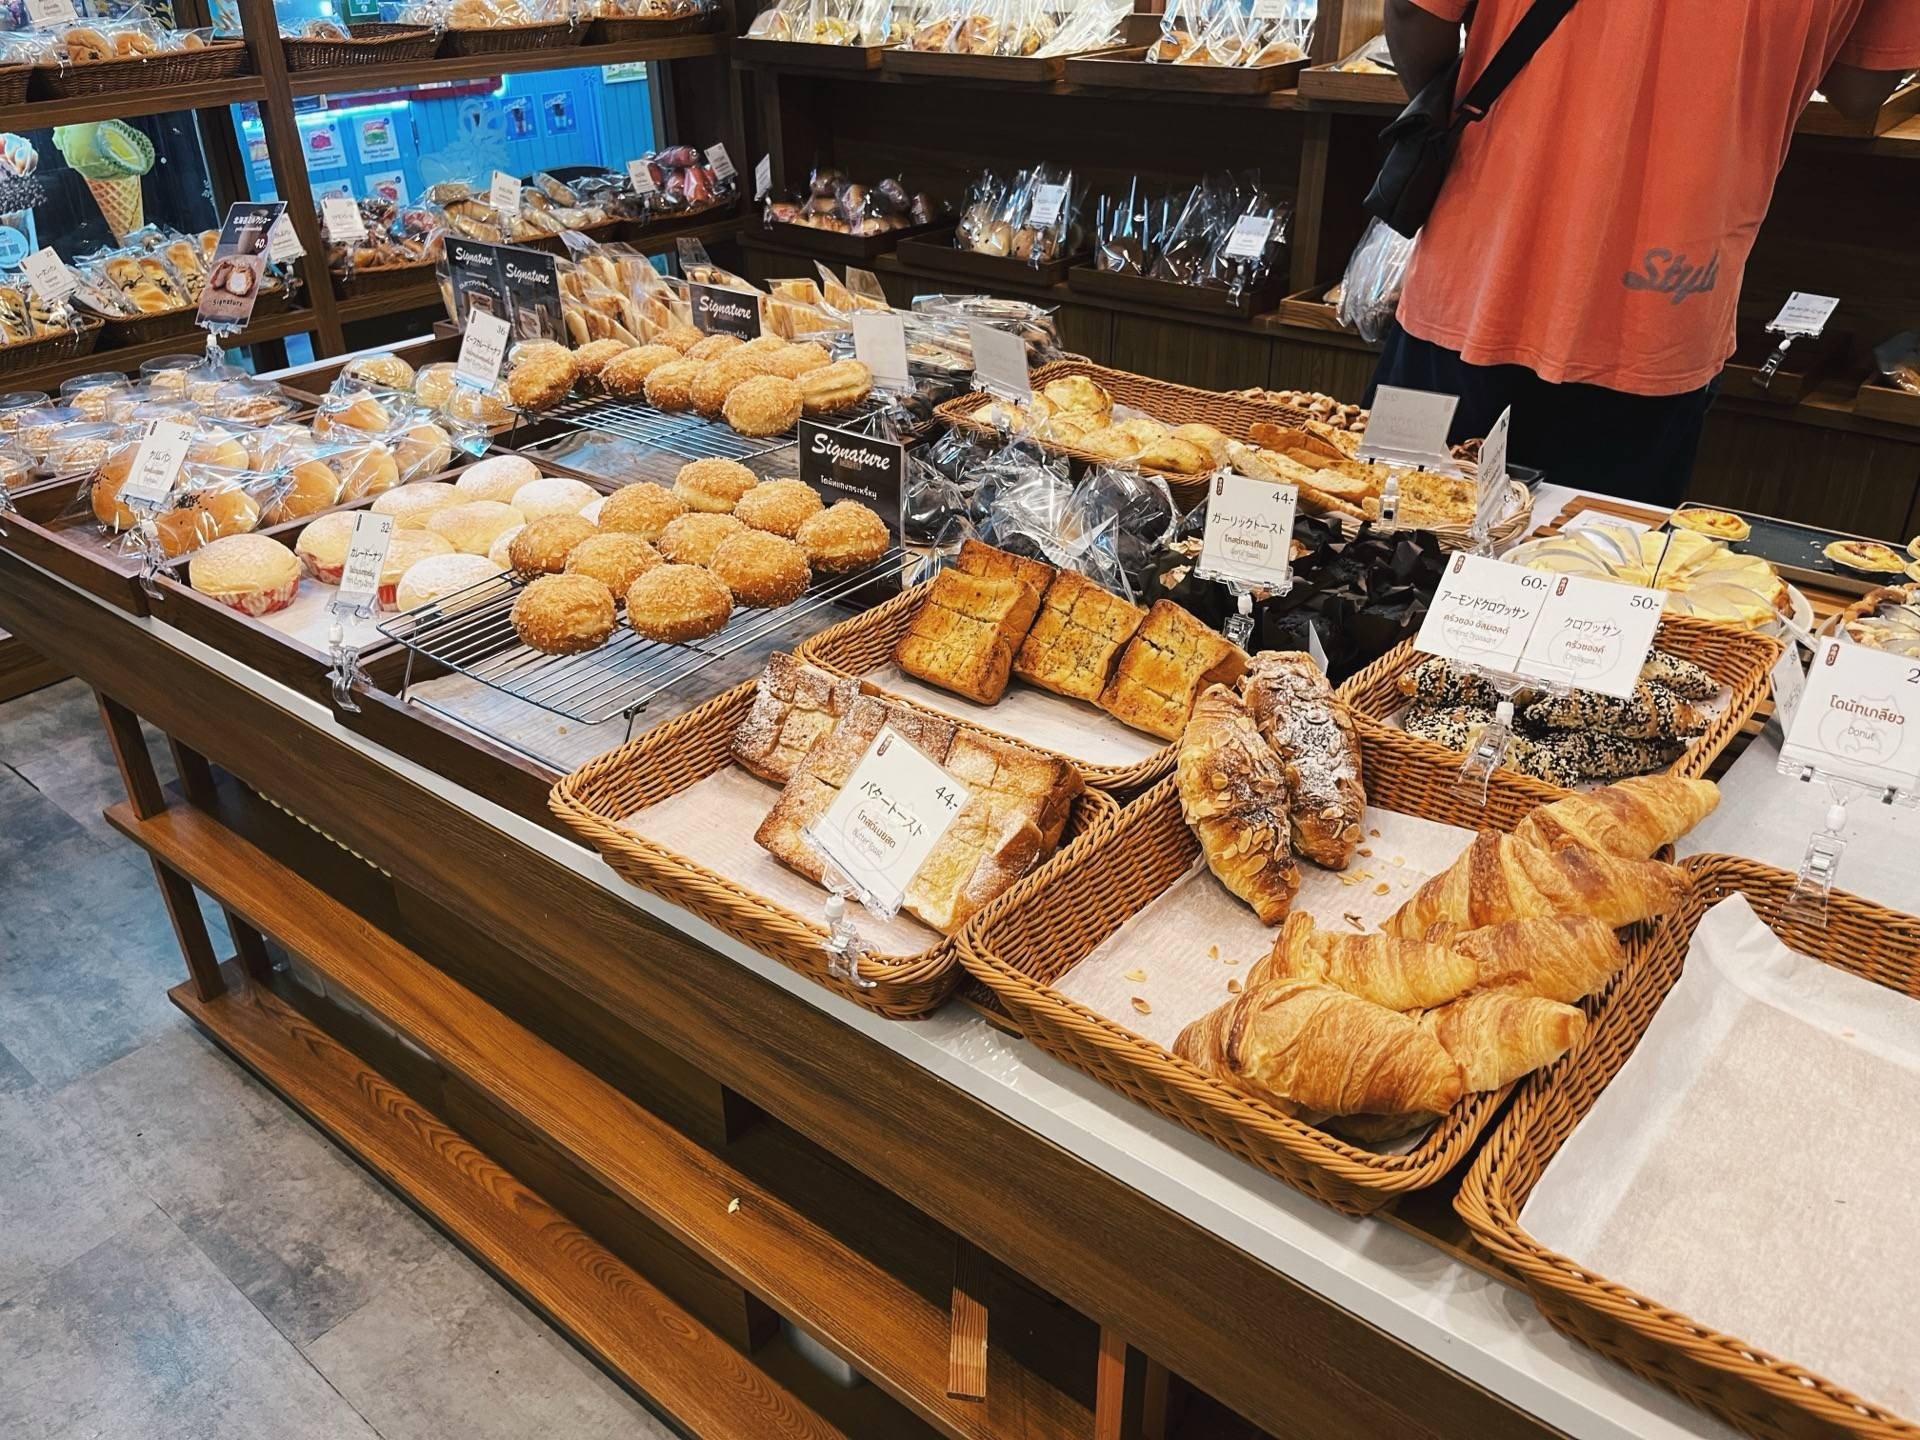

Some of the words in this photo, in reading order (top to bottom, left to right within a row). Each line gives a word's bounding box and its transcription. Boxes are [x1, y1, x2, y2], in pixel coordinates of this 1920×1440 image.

[455, 247, 493, 266] Signature
[505, 263, 550, 285] Signature
[1622, 246, 1720, 306] Styl
[699, 295, 752, 319] Signature
[811, 433, 891, 470] Signature
[1272, 491, 1294, 505] 44.-
[1212, 512, 1285, 535] ガーリックトースト
[1521, 575, 1548, 591] 60.-
[1440, 590, 1530, 620] アーモンドクロワッサン
[1630, 595, 1660, 611] 50.-
[1564, 616, 1623, 637] クロワッサン
[1830, 694, 1905, 725] โดนัทเกลียว
[1847, 726, 1876, 741] Donut
[935, 786, 958, 810] 44.-
